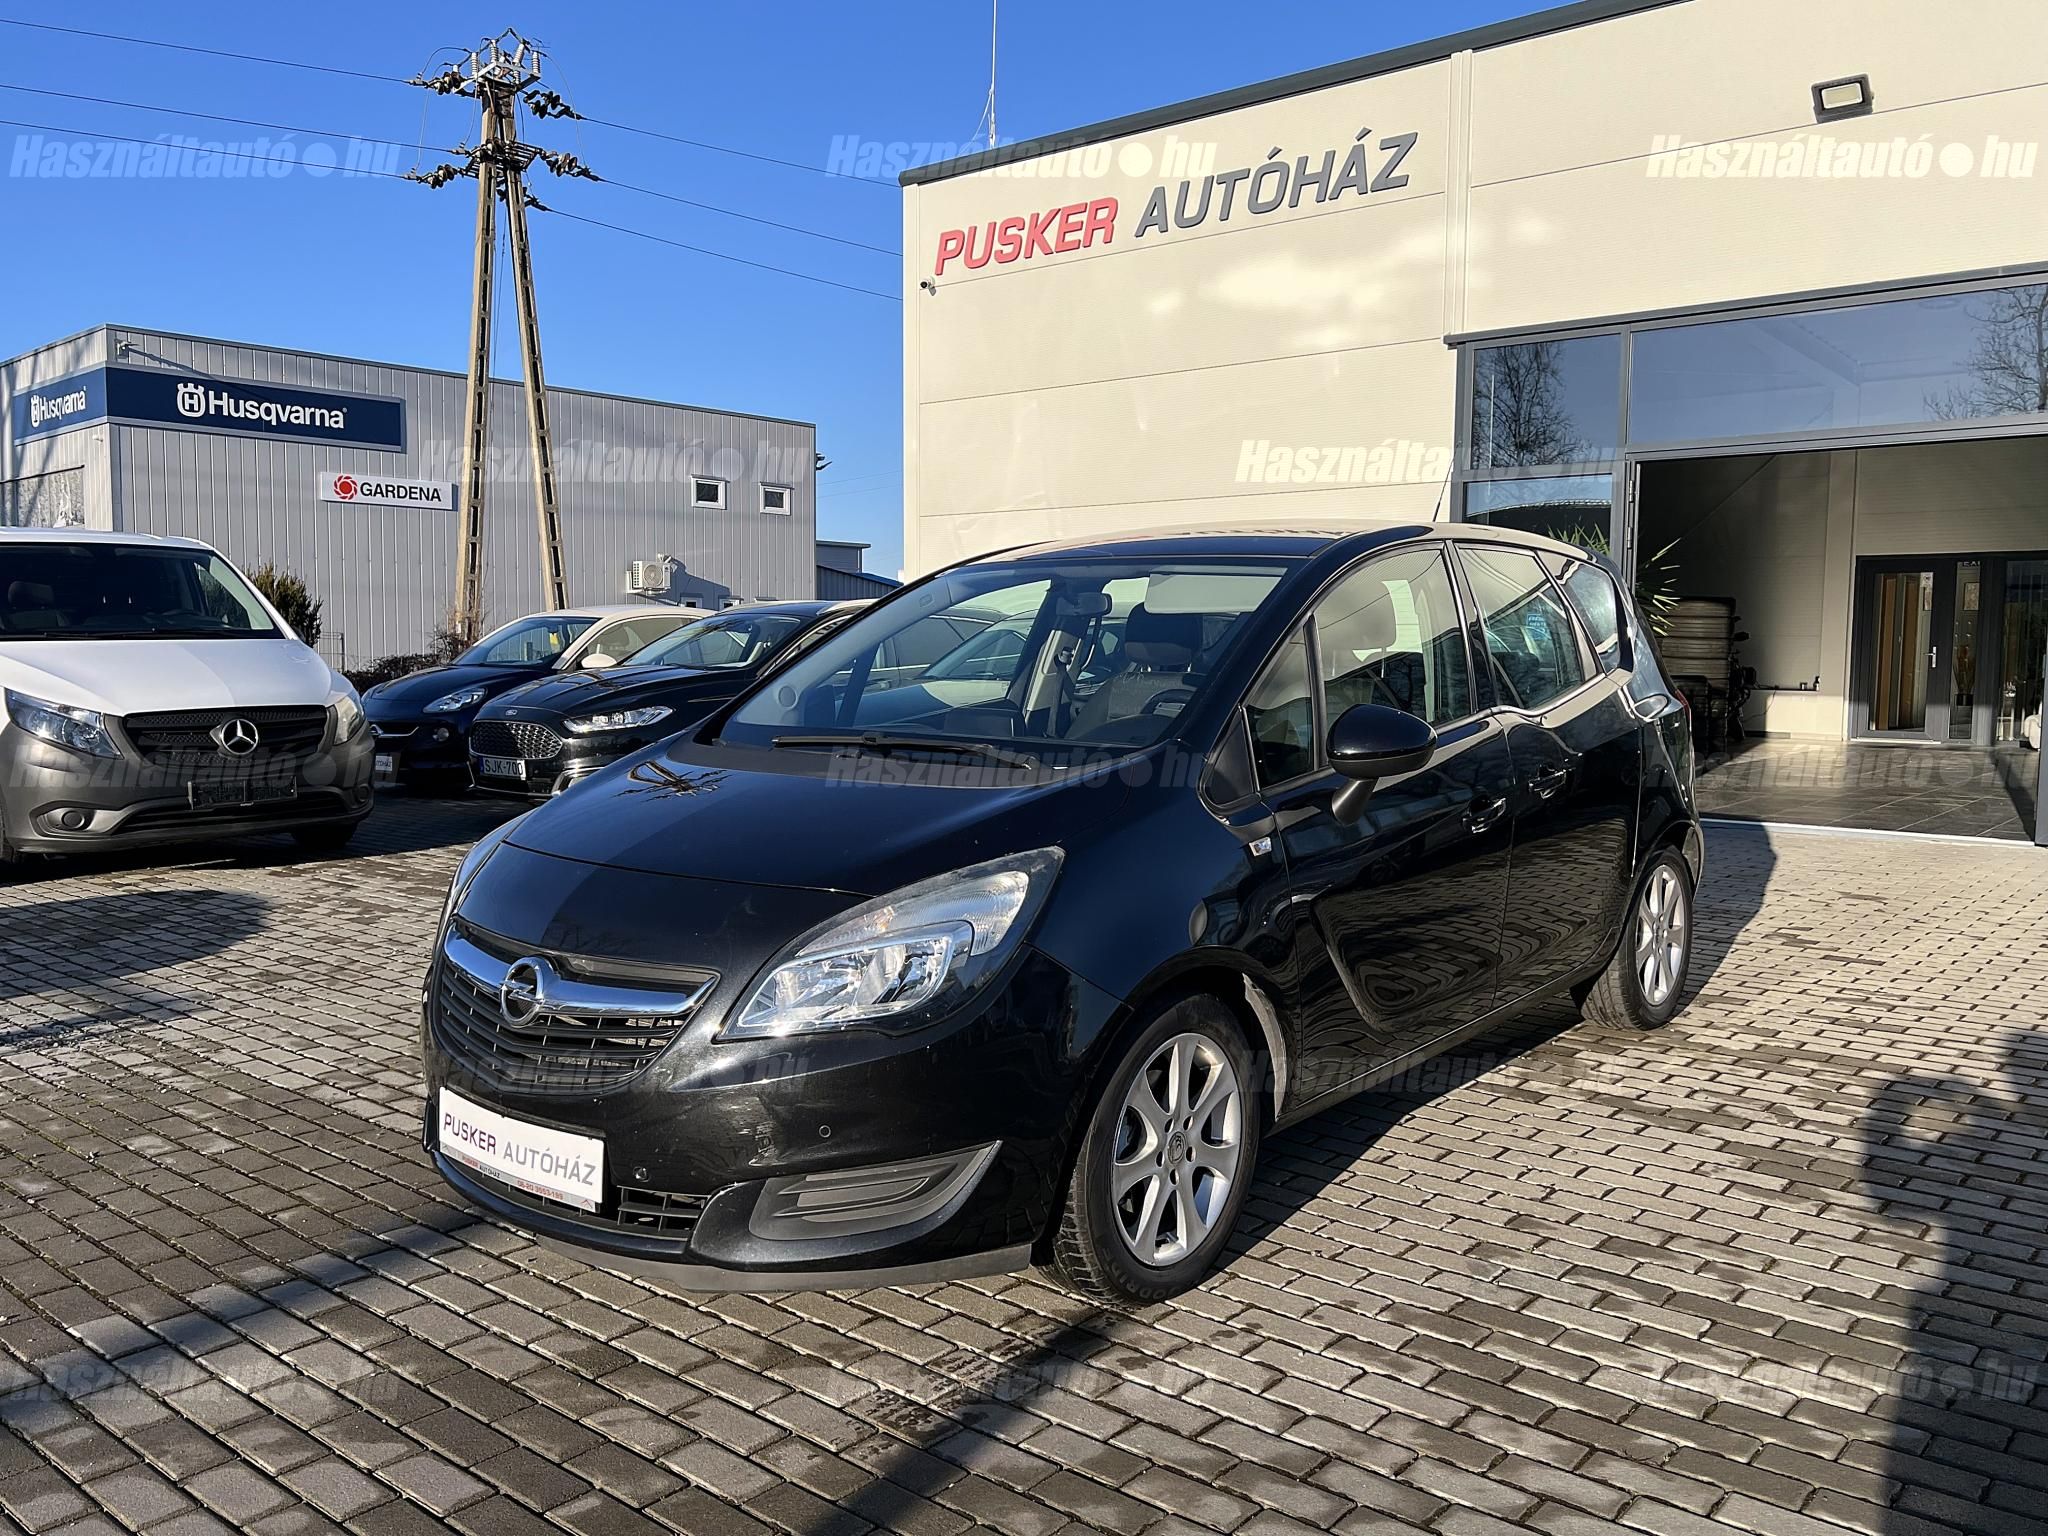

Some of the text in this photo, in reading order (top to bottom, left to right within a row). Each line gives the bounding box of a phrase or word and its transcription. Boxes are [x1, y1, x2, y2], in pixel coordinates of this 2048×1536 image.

[934, 127, 1418, 276] PUSKER AUTÓHÁZ
[40, 391, 86, 420] Husqvarna
[208, 390, 345, 429] Husqvarna
[360, 482, 441, 502] GARDENA
[485, 759, 523, 776] SJK-700
[443, 1112, 596, 1186] PUSKER AUTÓHÁZ
